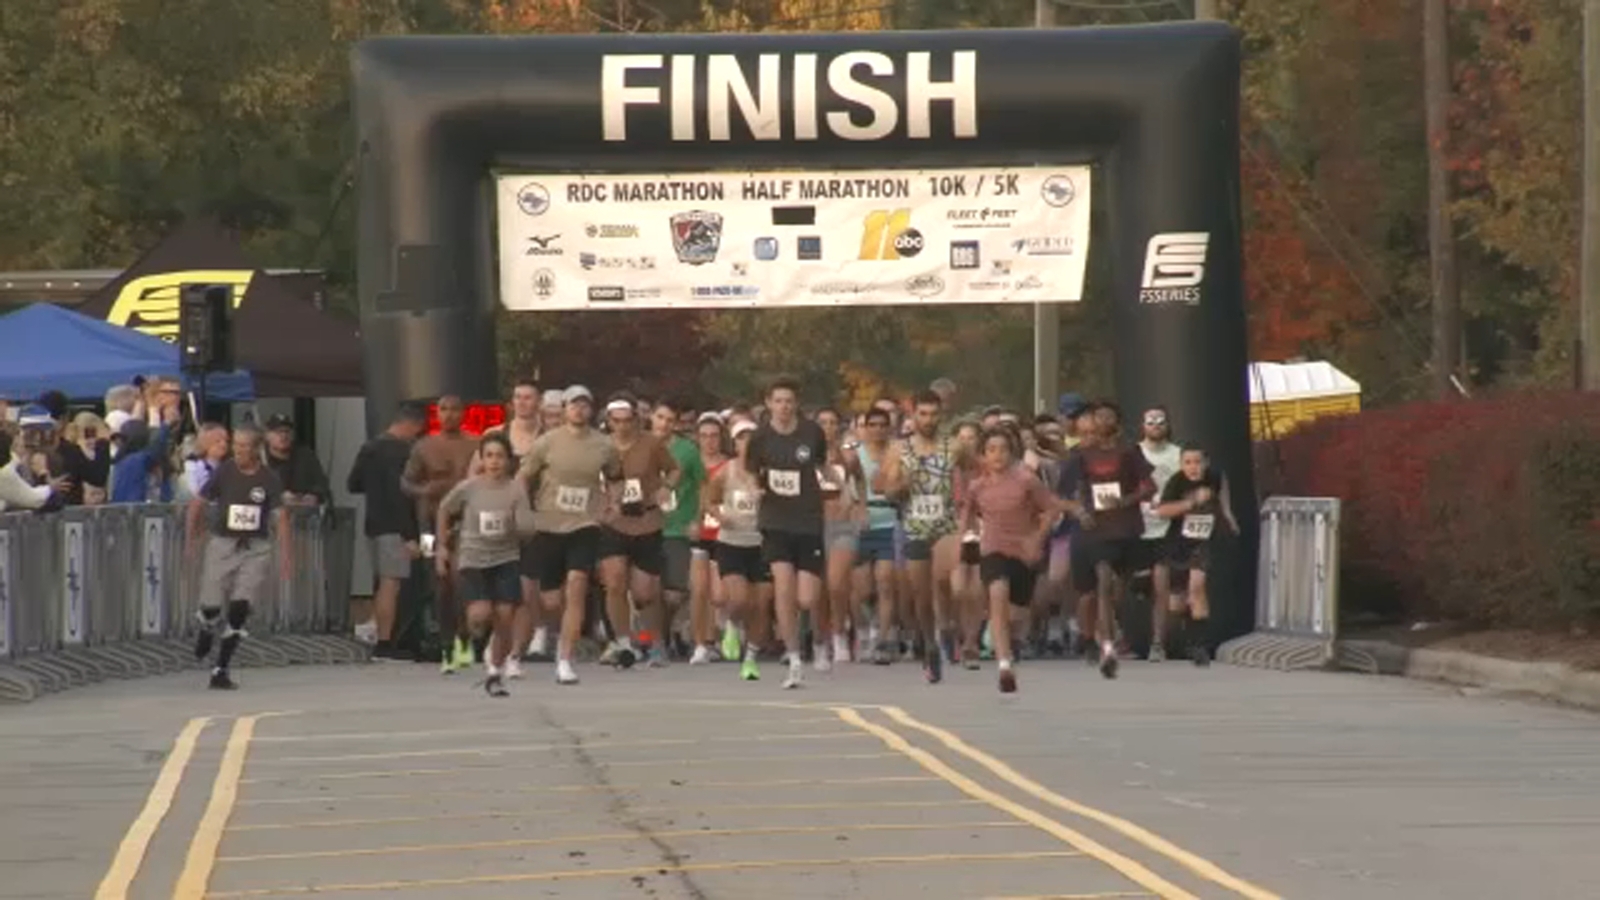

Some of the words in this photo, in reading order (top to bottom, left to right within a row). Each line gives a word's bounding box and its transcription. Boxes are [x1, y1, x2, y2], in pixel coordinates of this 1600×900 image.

[602, 51, 978, 141] FINISH
[566, 183, 606, 202] RDC
[613, 182, 724, 201] MARATHON
[742, 180, 792, 199] HALF
[800, 179, 909, 198] MARATHON
[929, 176, 966, 196] 10K
[993, 174, 1020, 195] 5K
[894, 236, 923, 248] abc
